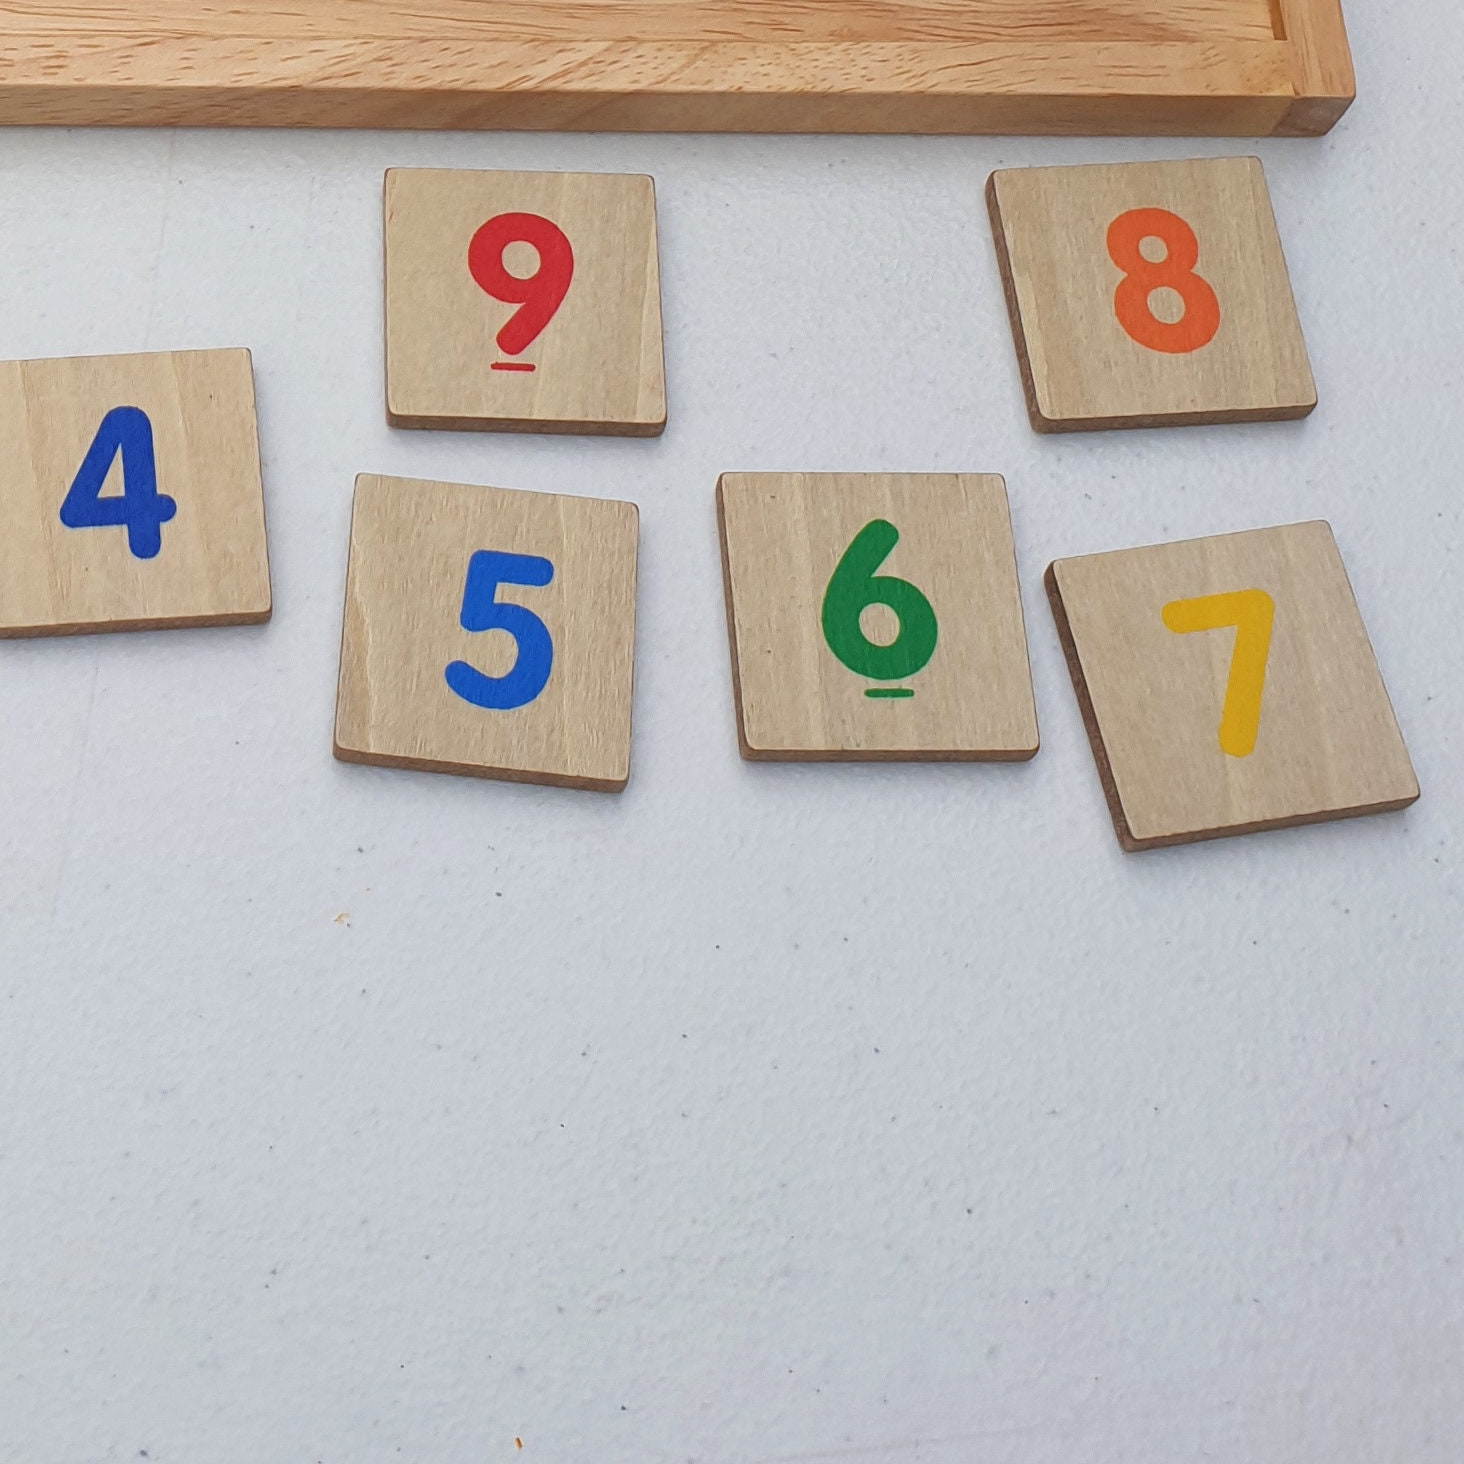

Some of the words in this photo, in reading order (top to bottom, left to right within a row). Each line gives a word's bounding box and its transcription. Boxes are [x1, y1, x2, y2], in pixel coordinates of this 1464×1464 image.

[468, 212, 574, 372] 9
[1107, 208, 1220, 353] 8
[59, 406, 177, 560] 4
[445, 550, 554, 710] 5
[821, 519, 938, 698] 6
[1162, 591, 1273, 756] 7
